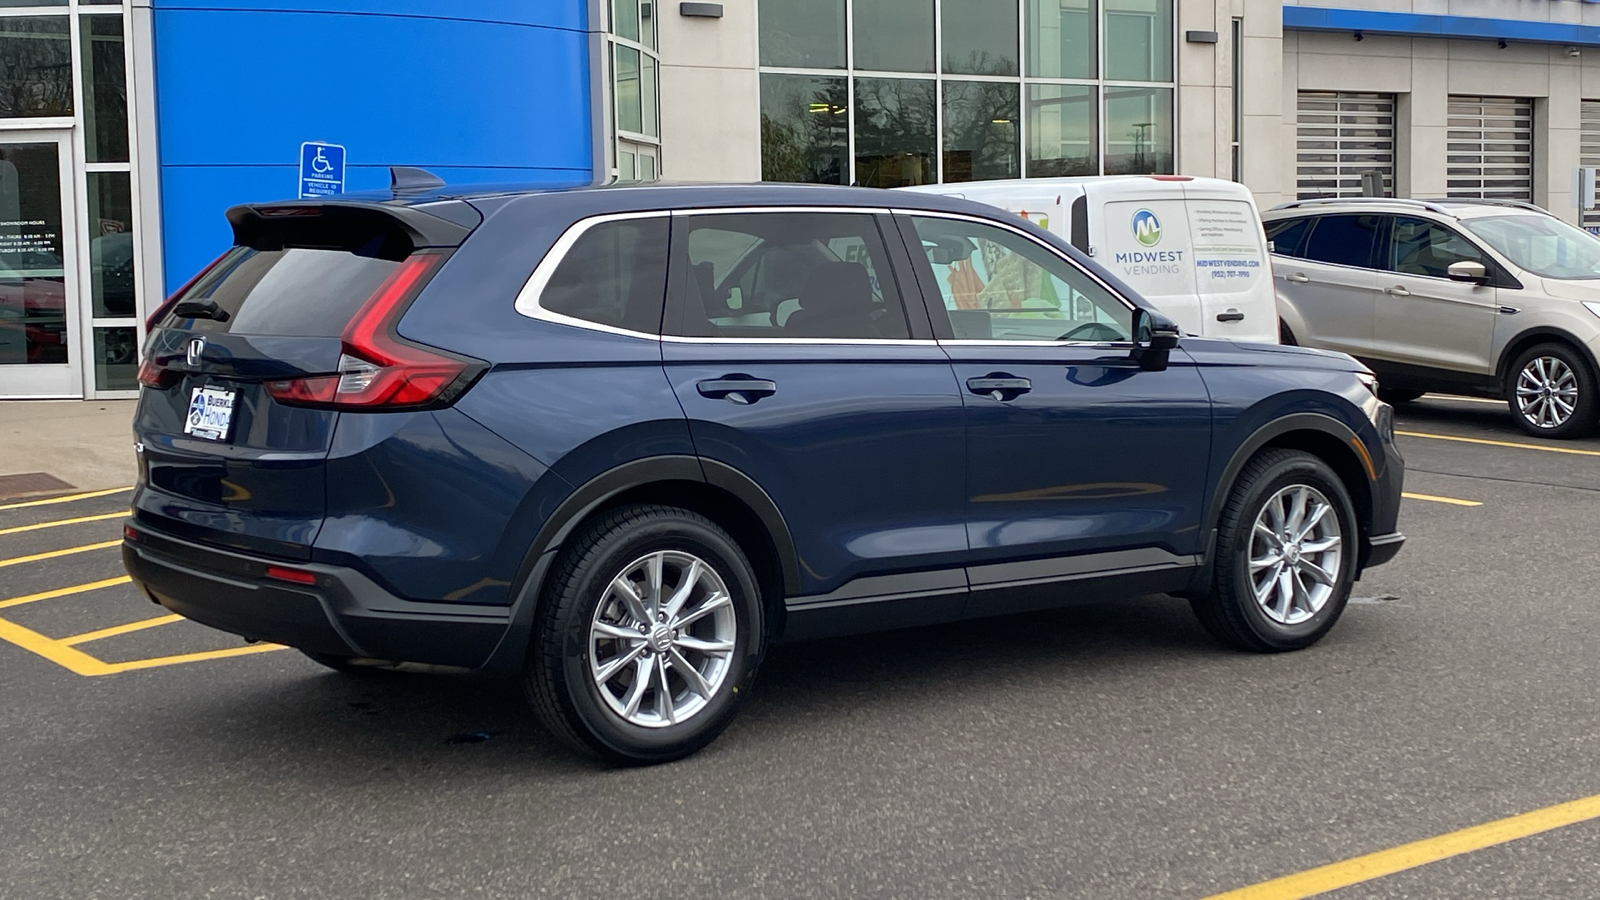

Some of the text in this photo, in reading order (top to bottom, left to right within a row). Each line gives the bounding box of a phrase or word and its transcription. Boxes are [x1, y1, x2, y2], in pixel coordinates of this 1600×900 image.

[1116, 251, 1183, 263] MIDWEST
[1123, 264, 1180, 275] VENDING
[203, 406, 230, 426] HONDA
